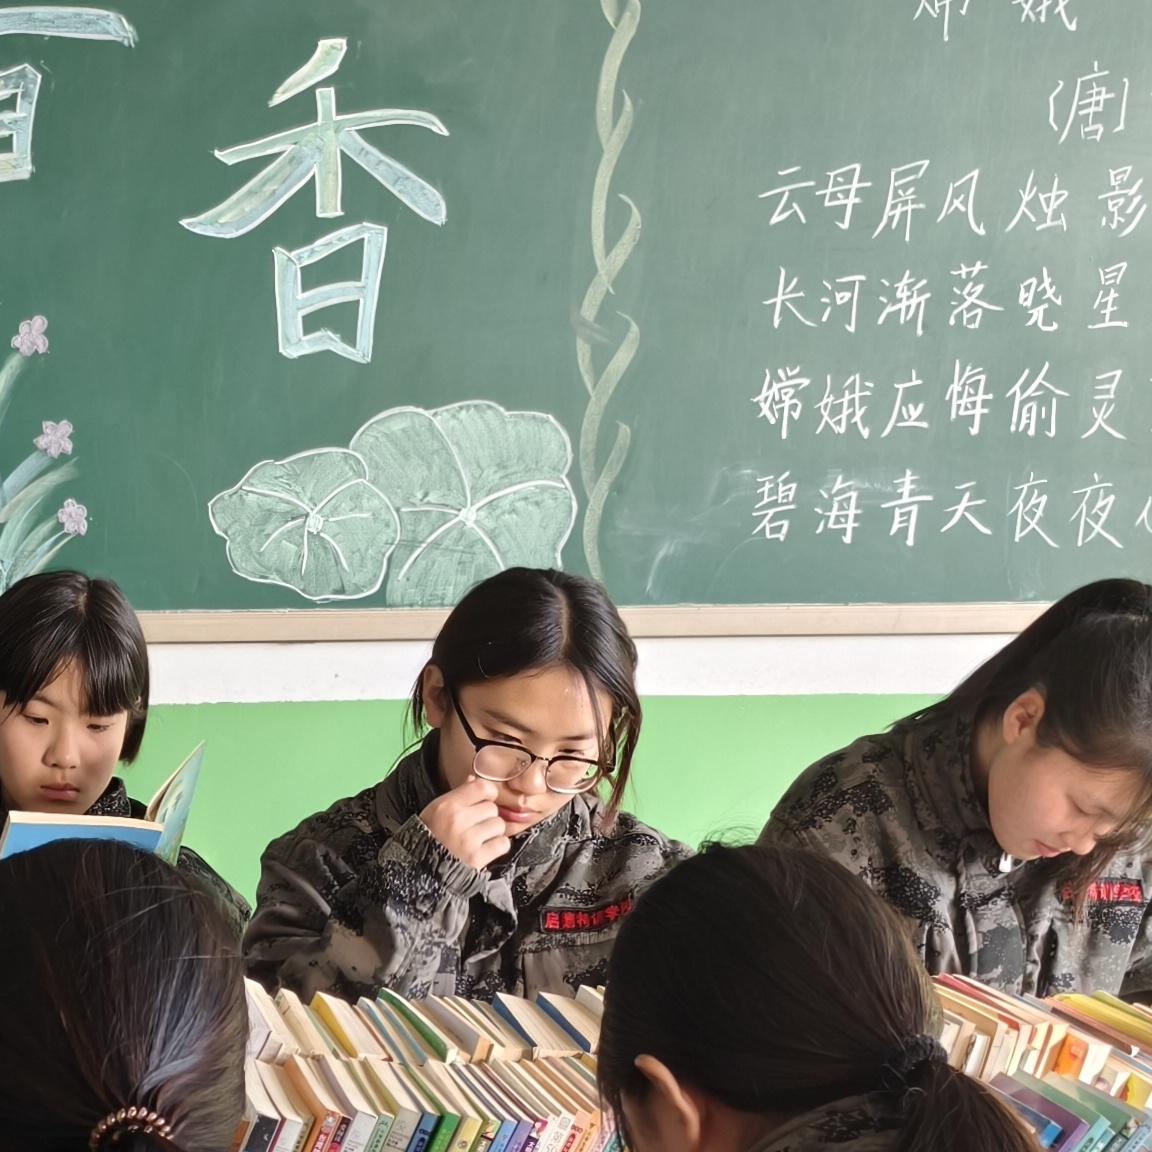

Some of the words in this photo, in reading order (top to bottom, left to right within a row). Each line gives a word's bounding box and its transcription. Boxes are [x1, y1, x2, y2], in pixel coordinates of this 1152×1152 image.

[758, 160, 1148, 242] 云母屏风烛影
[762, 261, 1129, 337] 长河渐落晓星
[750, 359, 1128, 441] 嫦娥应悔偷灵
